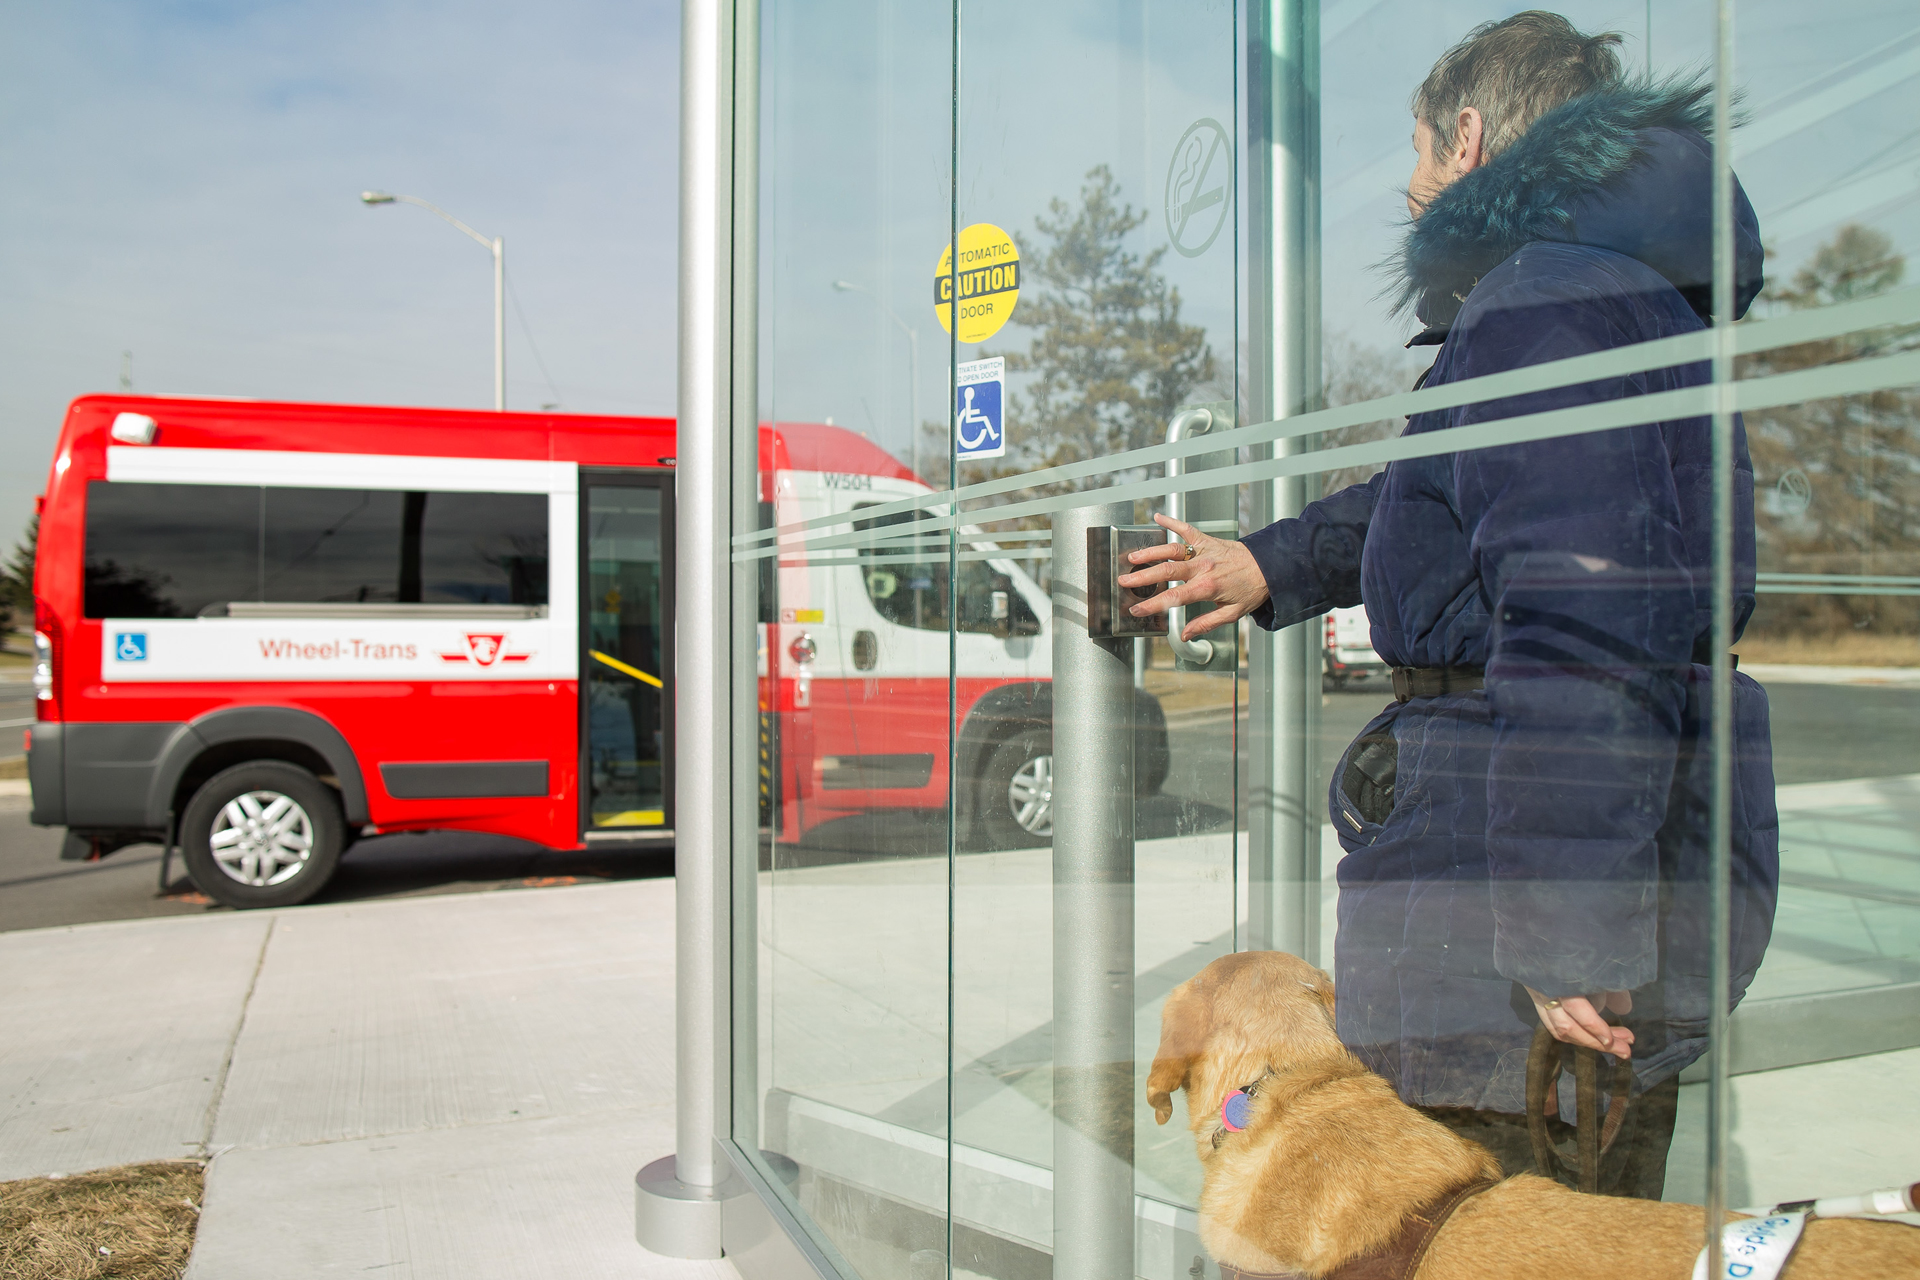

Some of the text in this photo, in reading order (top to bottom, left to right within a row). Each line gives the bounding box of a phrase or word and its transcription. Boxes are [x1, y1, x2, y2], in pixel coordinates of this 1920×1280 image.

[945, 243, 1010, 267] ATOMATIC
[961, 303, 993, 319] DOOR
[958, 361, 1003, 374] TIVATE SWITCH
[963, 373, 980, 382] OPEN
[981, 370, 999, 380] DOOR
[824, 474, 872, 491] W504
[258, 638, 418, 660] Wheel-Trans
[1726, 1263, 1754, 1280] D
